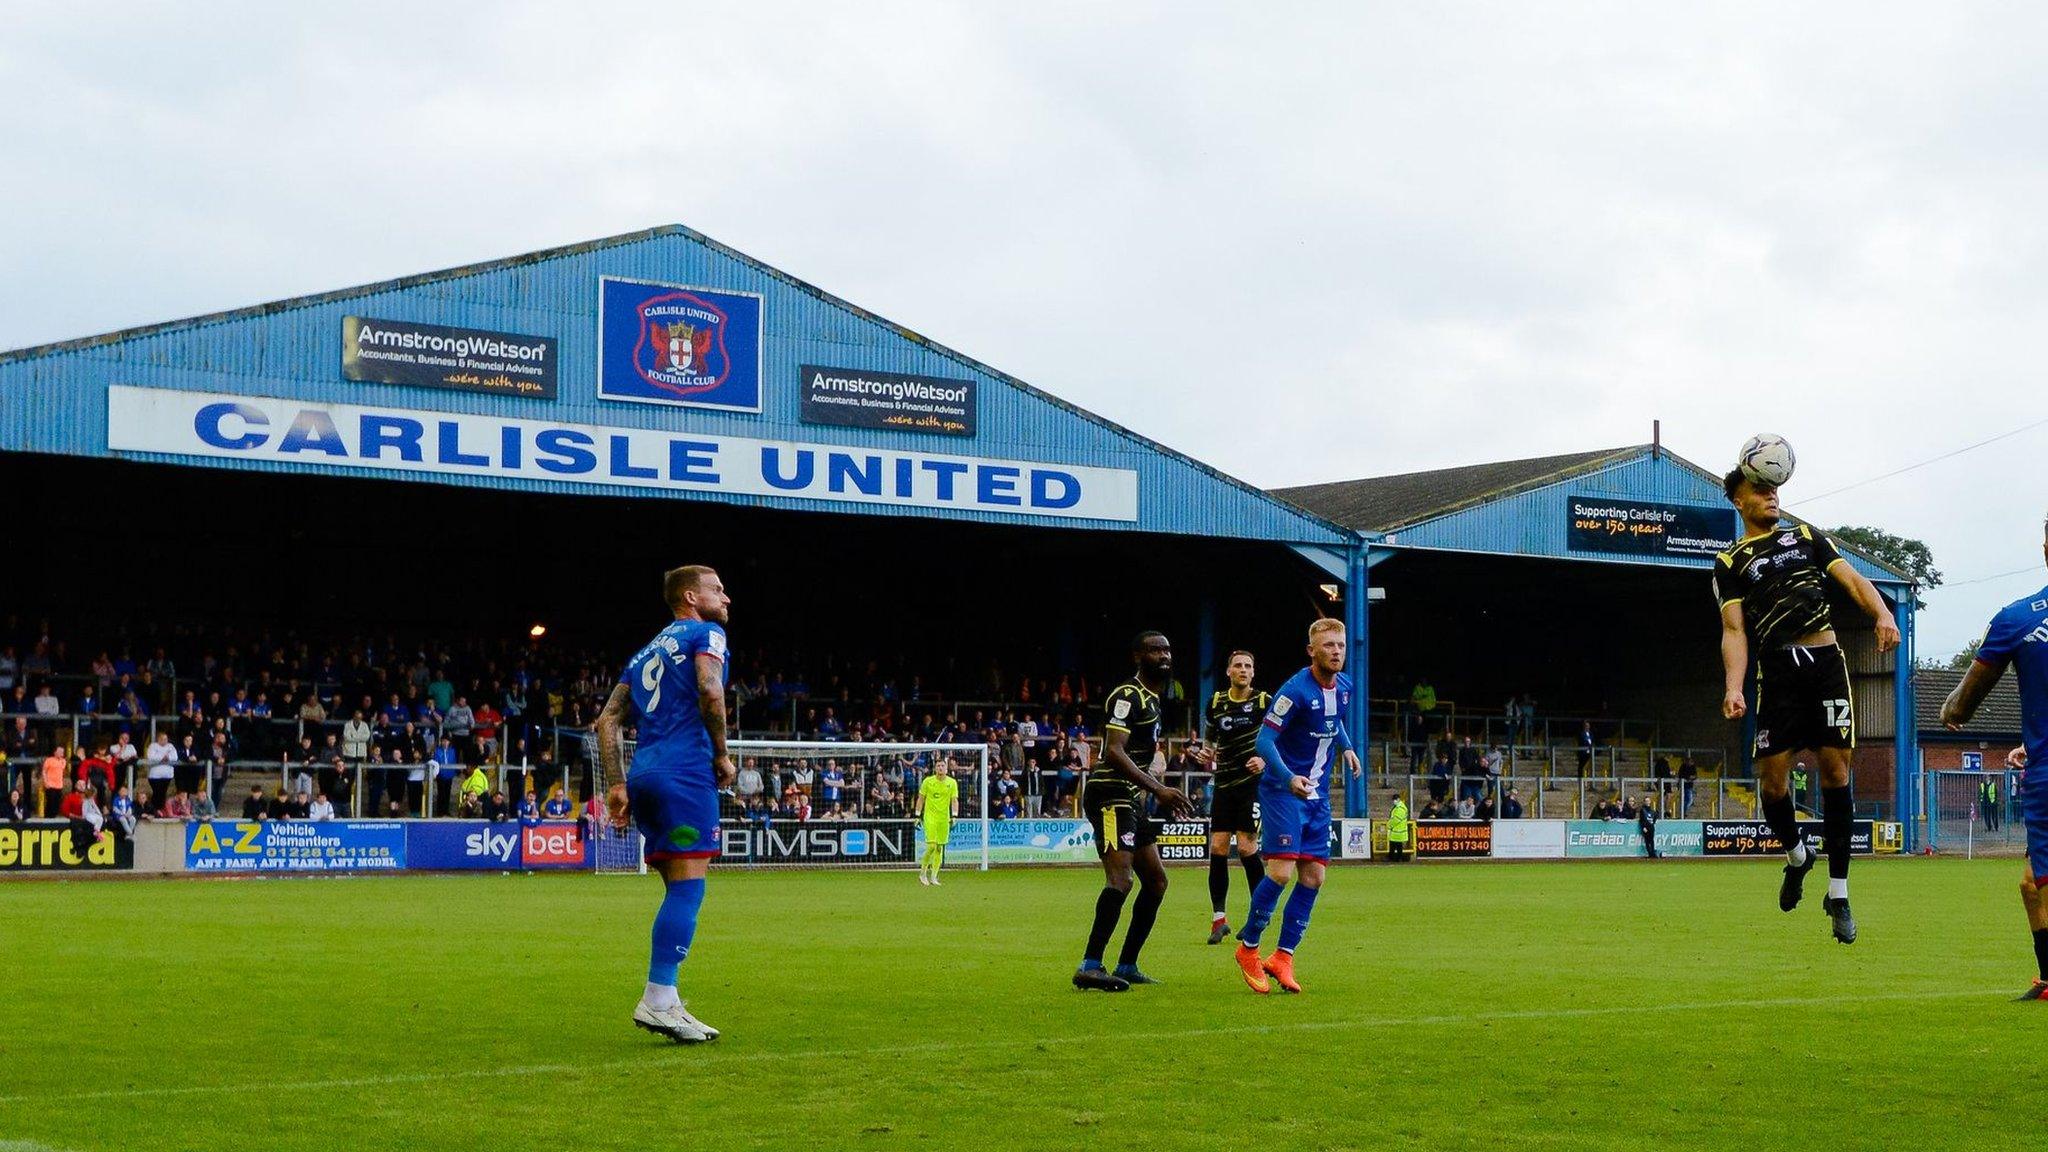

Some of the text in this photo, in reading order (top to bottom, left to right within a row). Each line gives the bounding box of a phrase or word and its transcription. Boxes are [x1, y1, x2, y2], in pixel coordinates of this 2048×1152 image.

[644, 306, 720, 324] CARLISLE UNITED
[357, 348, 416, 364] Accountants,
[418, 354, 457, 367] Business
[467, 359, 504, 372] Financial
[483, 376, 513, 388] with
[517, 381, 544, 392] you
[648, 369, 692, 385] FOOTBALL
[693, 376, 715, 385] CLUB
[861, 398, 894, 410] Business
[902, 402, 933, 413] Financial
[916, 416, 941, 427] with
[943, 420, 965, 430] you
[194, 403, 1082, 508] CARLISLE UNITED
[1574, 504, 1676, 522] Supporting Carlisle for
[1576, 520, 1664, 537] over 150 years
[642, 653, 665, 713] 9
[1822, 699, 1851, 727] 12
[270, 823, 316, 836] Vehicle
[991, 822, 1029, 833] WASTE
[1034, 822, 1074, 833] GROUP
[1162, 824, 1204, 835] 527575
[1706, 824, 1757, 837] Supporting
[190, 823, 263, 854] A-Z
[266, 834, 341, 847] Dismantlers
[466, 827, 518, 862] sky
[528, 829, 578, 855] bet
[721, 829, 902, 857] BIMSON
[1418, 841, 1449, 850] 01228
[1452, 841, 1489, 850] 317340
[1569, 831, 1624, 846] Carabao
[1671, 833, 1701, 846] DRINK
[1707, 839, 1732, 849] over
[1736, 837, 1755, 853] 150
[1162, 846, 1204, 858] 515818
[195, 858, 223, 869] ANY
[260, 858, 286, 868] ANY
[329, 858, 355, 868] ANY
